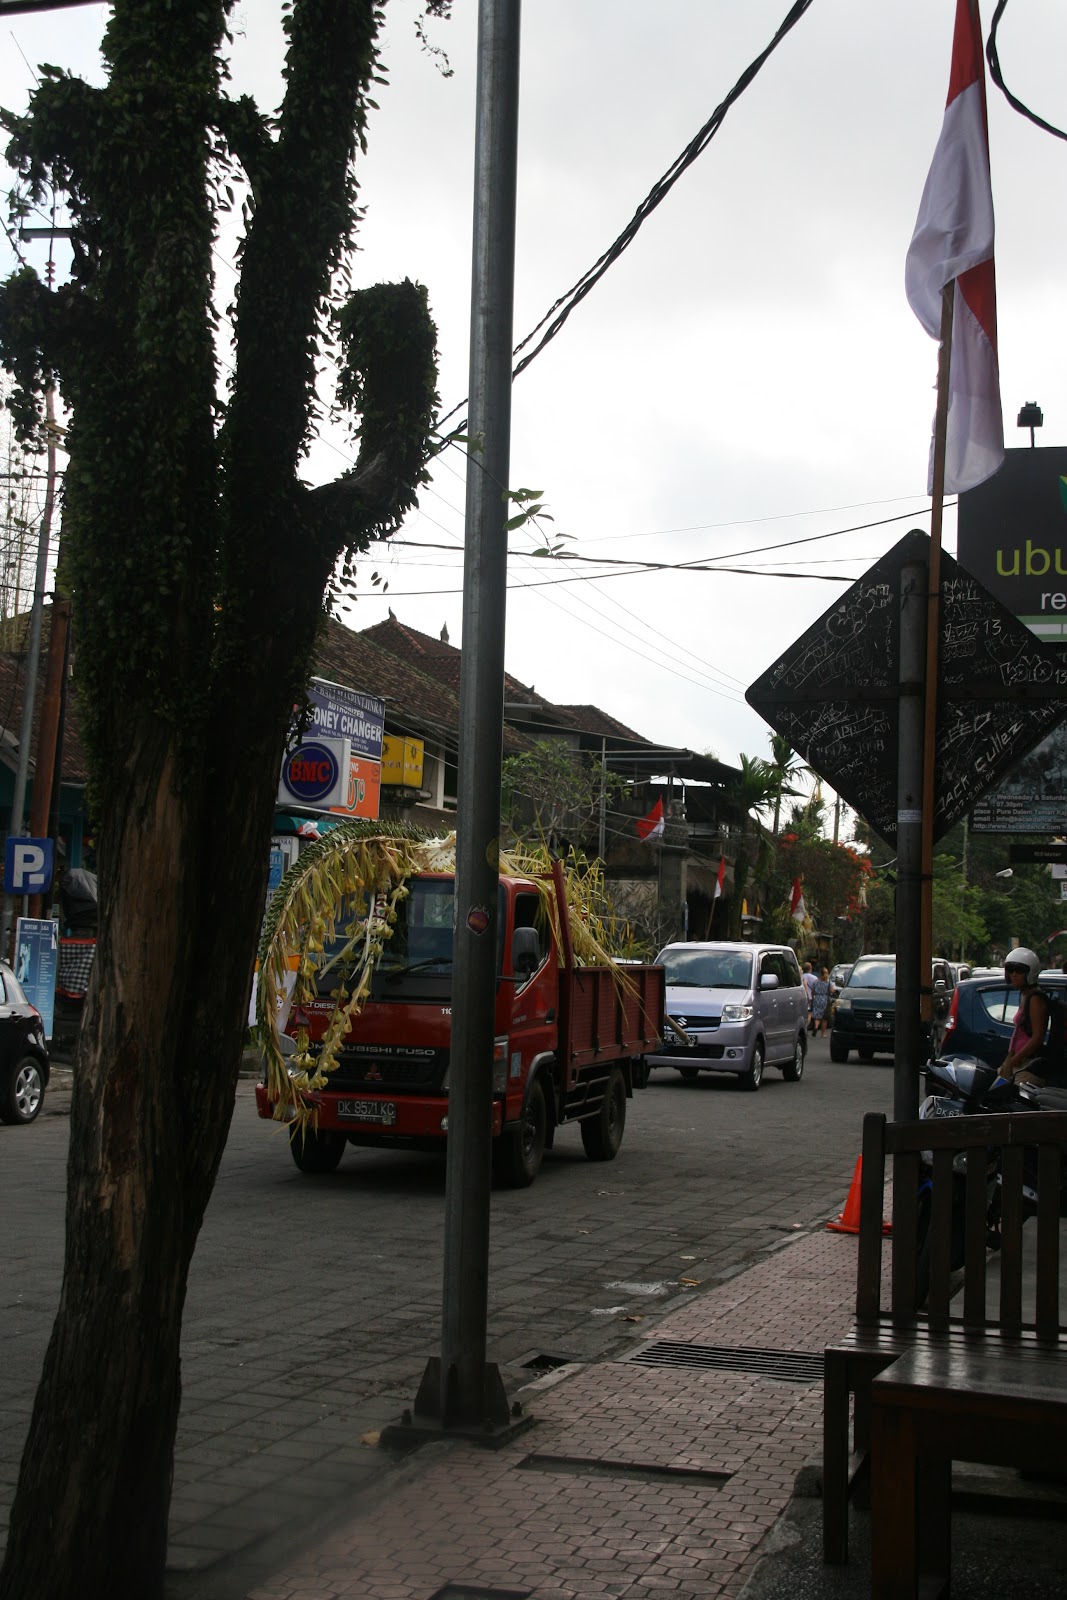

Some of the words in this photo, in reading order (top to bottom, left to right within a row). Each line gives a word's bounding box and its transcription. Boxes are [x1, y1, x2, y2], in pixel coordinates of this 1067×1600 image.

[327, 700, 365, 719] AUTHORIZED
[306, 706, 340, 730] ONEY
[340, 715, 382, 743] CHANGER
[290, 760, 331, 784] BMC
[12, 844, 45, 887] P
[313, 1043, 392, 1055] MSUBISHI
[396, 1046, 436, 1056] FUSO
[337, 1100, 351, 1114] DK
[354, 1101, 378, 1115] 9571
